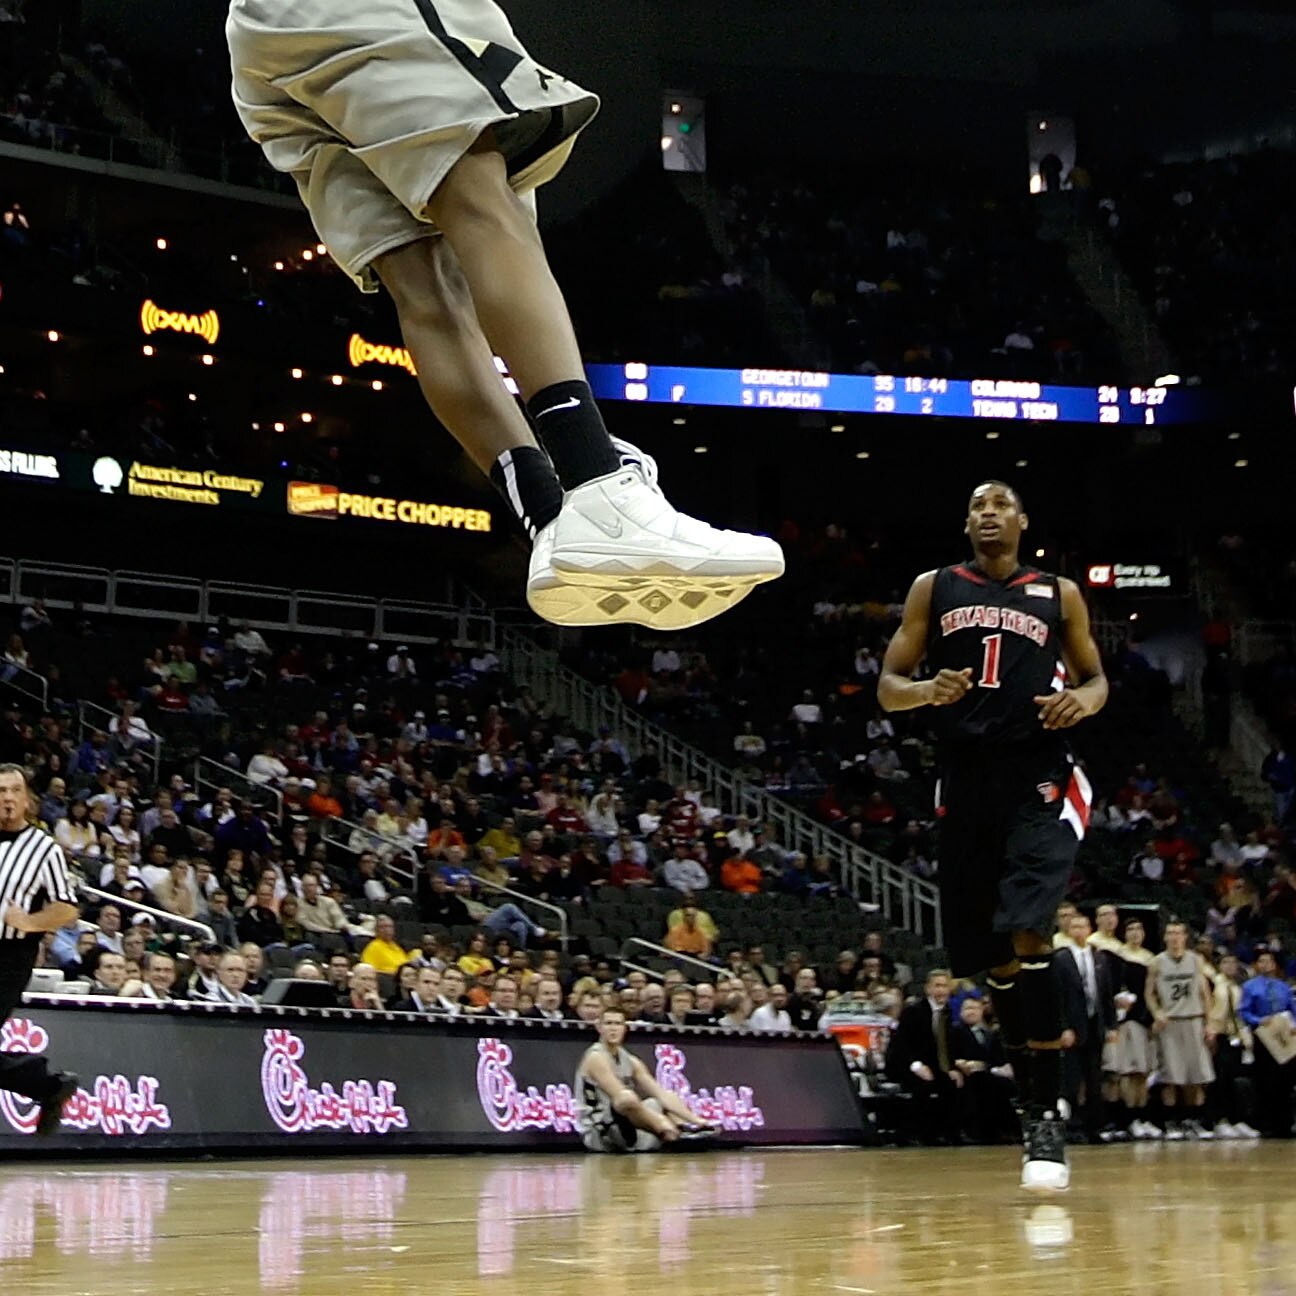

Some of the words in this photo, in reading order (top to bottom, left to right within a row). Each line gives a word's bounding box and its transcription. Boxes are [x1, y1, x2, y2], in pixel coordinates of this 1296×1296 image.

[128, 460, 203, 486] American
[203, 470, 264, 498] Century
[128, 477, 220, 505] Investments
[338, 492, 397, 521] PRICE
[397, 500, 492, 532] CHOPPER
[941, 605, 1001, 636] TEXAS
[1001, 607, 1048, 647] TECH
[978, 633, 1002, 689] 1
